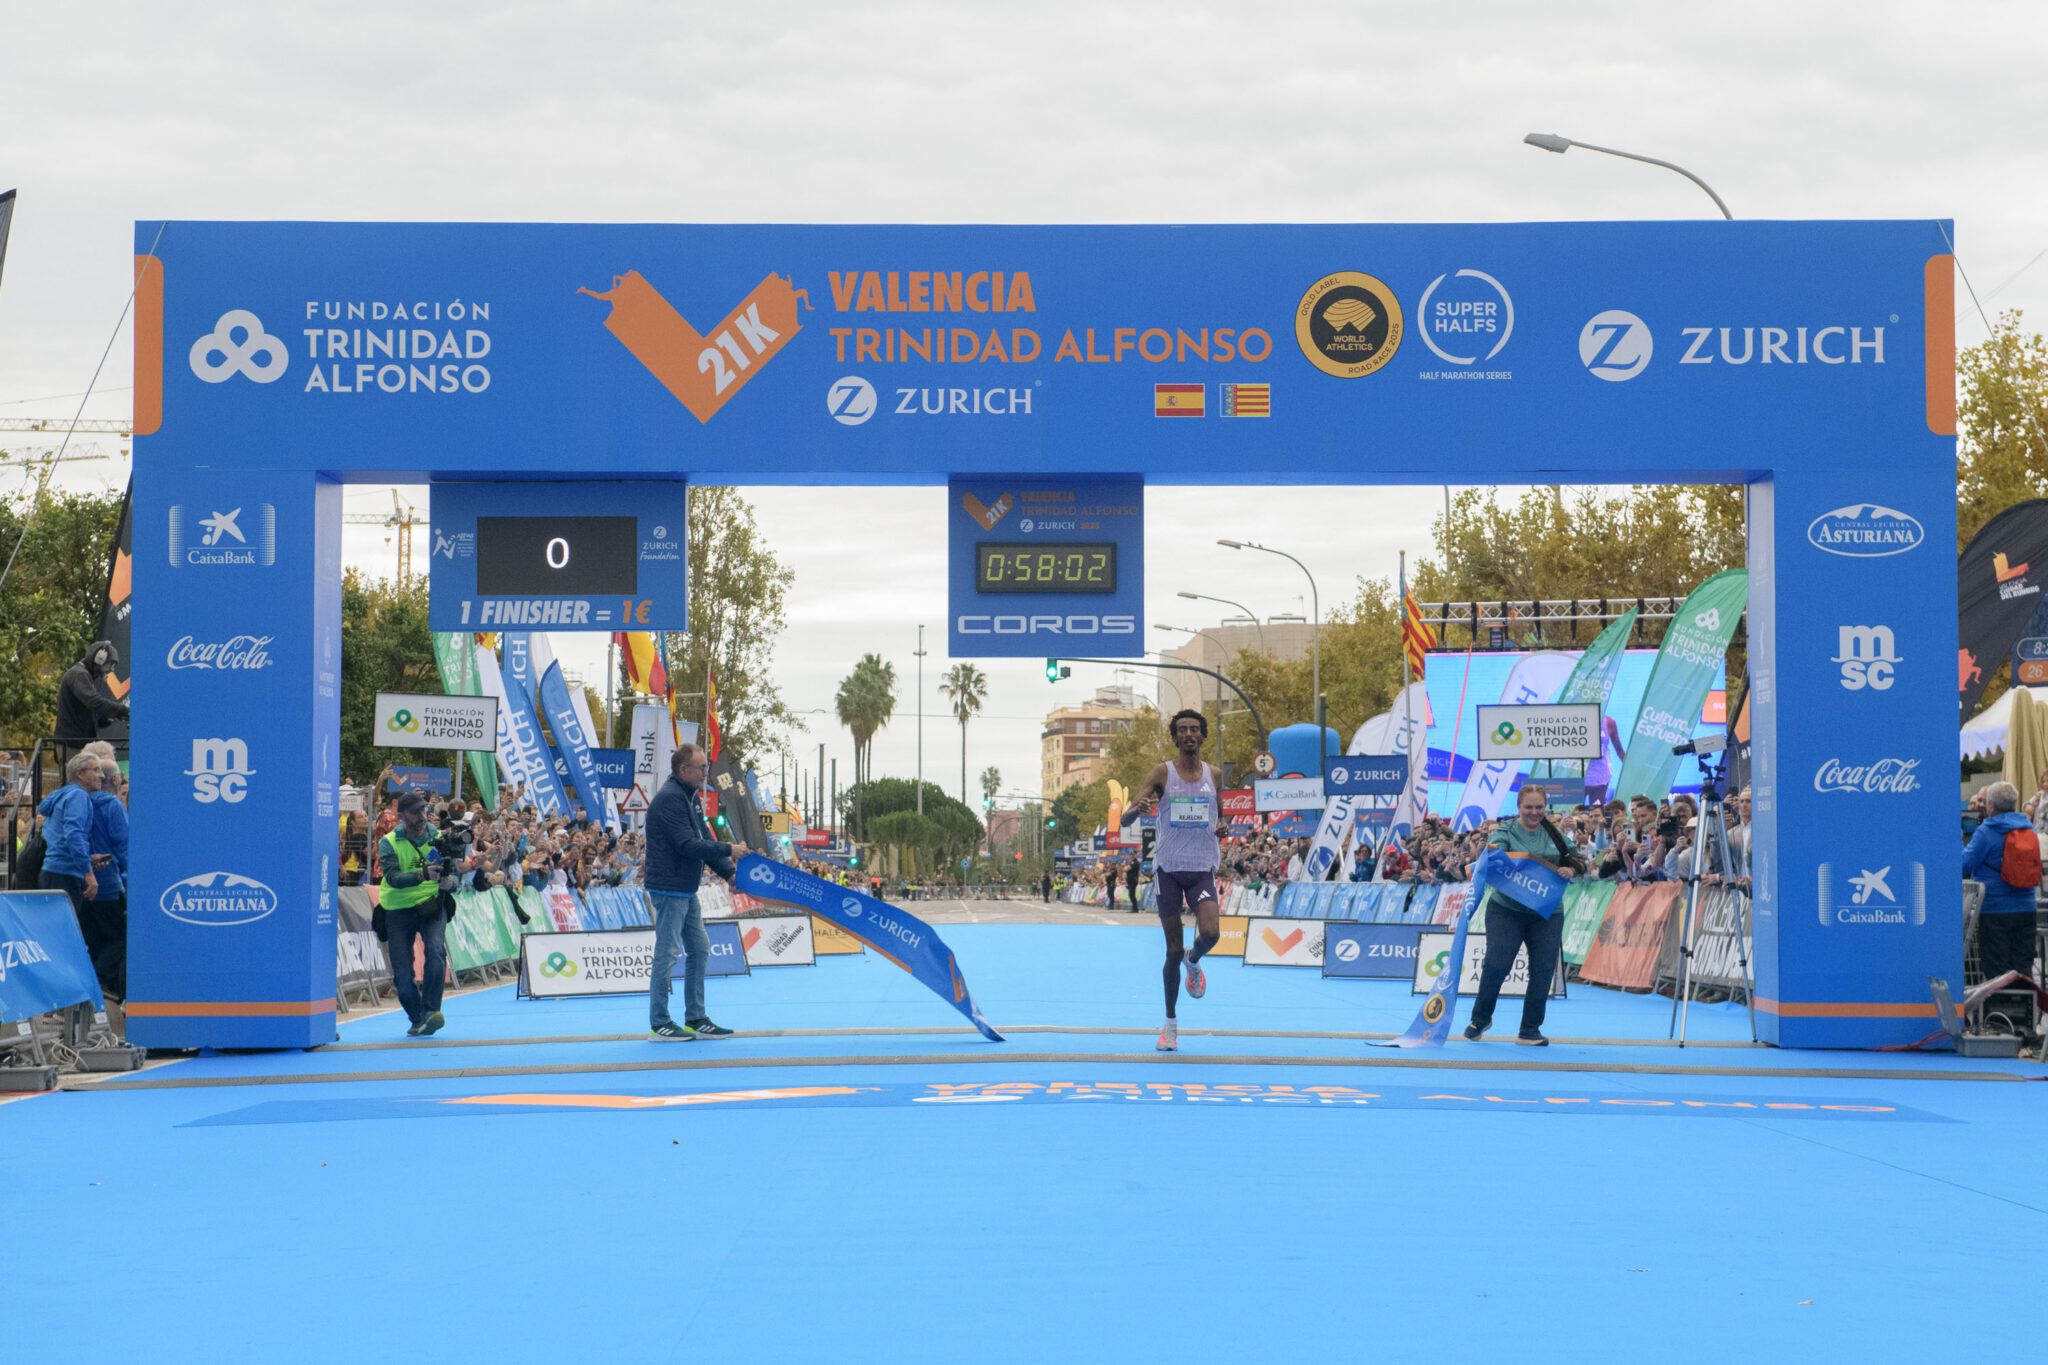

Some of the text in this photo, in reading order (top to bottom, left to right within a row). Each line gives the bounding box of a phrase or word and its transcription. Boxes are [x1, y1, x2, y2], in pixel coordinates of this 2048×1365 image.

[828, 271, 1036, 312] VALENCIA
[1301, 277, 1341, 316] GOLD LABEL
[306, 299, 490, 320] FUNDACIÓN
[1435, 302, 1497, 316] SUPER
[1435, 319, 1496, 333] HALFS
[304, 328, 491, 359] TRINIDAD
[829, 328, 1272, 363] TRINIDAD ALFONSO
[1333, 335, 1365, 343] WORLD
[1679, 326, 1886, 364] ZURICH
[698, 302, 780, 396] 21K
[1348, 361, 1373, 374] ROAD
[1372, 345, 1392, 366] RACE
[304, 364, 490, 393] ALFONSO
[1420, 372, 1512, 380] HALF MARATHON SERIES
[894, 388, 1033, 414] ZURICH
[1020, 491, 1076, 502] VALENCIA
[986, 499, 1008, 524] 21K
[1020, 506, 1139, 516] TRINIDAD ALFONSO
[1038, 522, 1075, 530] ZURICH
[1817, 523, 1915, 543] ASTURIANA
[546, 537, 570, 569] 0
[642, 542, 678, 550] ZURICH
[188, 550, 256, 564] CaixaBank
[640, 551, 680, 560] Foundation
[986, 554, 1107, 581] 0:58:02
[461, 601, 471, 624] 1
[480, 600, 590, 624] FINISHER
[622, 600, 652, 624] 1€
[958, 616, 1135, 634] COROS
[167, 635, 276, 670] Coca-Cola
[1665, 644, 1720, 670] ALFONSO
[424, 707, 484, 716] FUNDACIÓN
[424, 716, 484, 729] TRINIDAD
[1528, 716, 1587, 724] FUNDACIÓN
[424, 728, 483, 739] ALFONSO
[1527, 726, 1588, 736] TRINIDAD
[1528, 736, 1588, 748] ALFONSO
[1354, 770, 1400, 780] ZURICH
[1814, 758, 1922, 792] Coca-Cola
[1276, 789, 1318, 799] CaixaBank
[777, 881, 822, 902] ALFONSO
[780, 874, 823, 896] TRINIDAD
[170, 892, 268, 912] ASTURIANA
[1837, 910, 1906, 924] CaixaBank
[868, 911, 921, 949] ZURICH
[582, 944, 652, 954] FUNDACIÓN
[1368, 944, 1420, 958] ZURIC
[582, 955, 654, 967] TRINIDAD
[926, 1082, 1364, 1092] VALENCIA
[924, 1088, 1896, 1112] TRINIDAD ALFONSO
[1064, 1094, 1368, 1104] ZURICH
